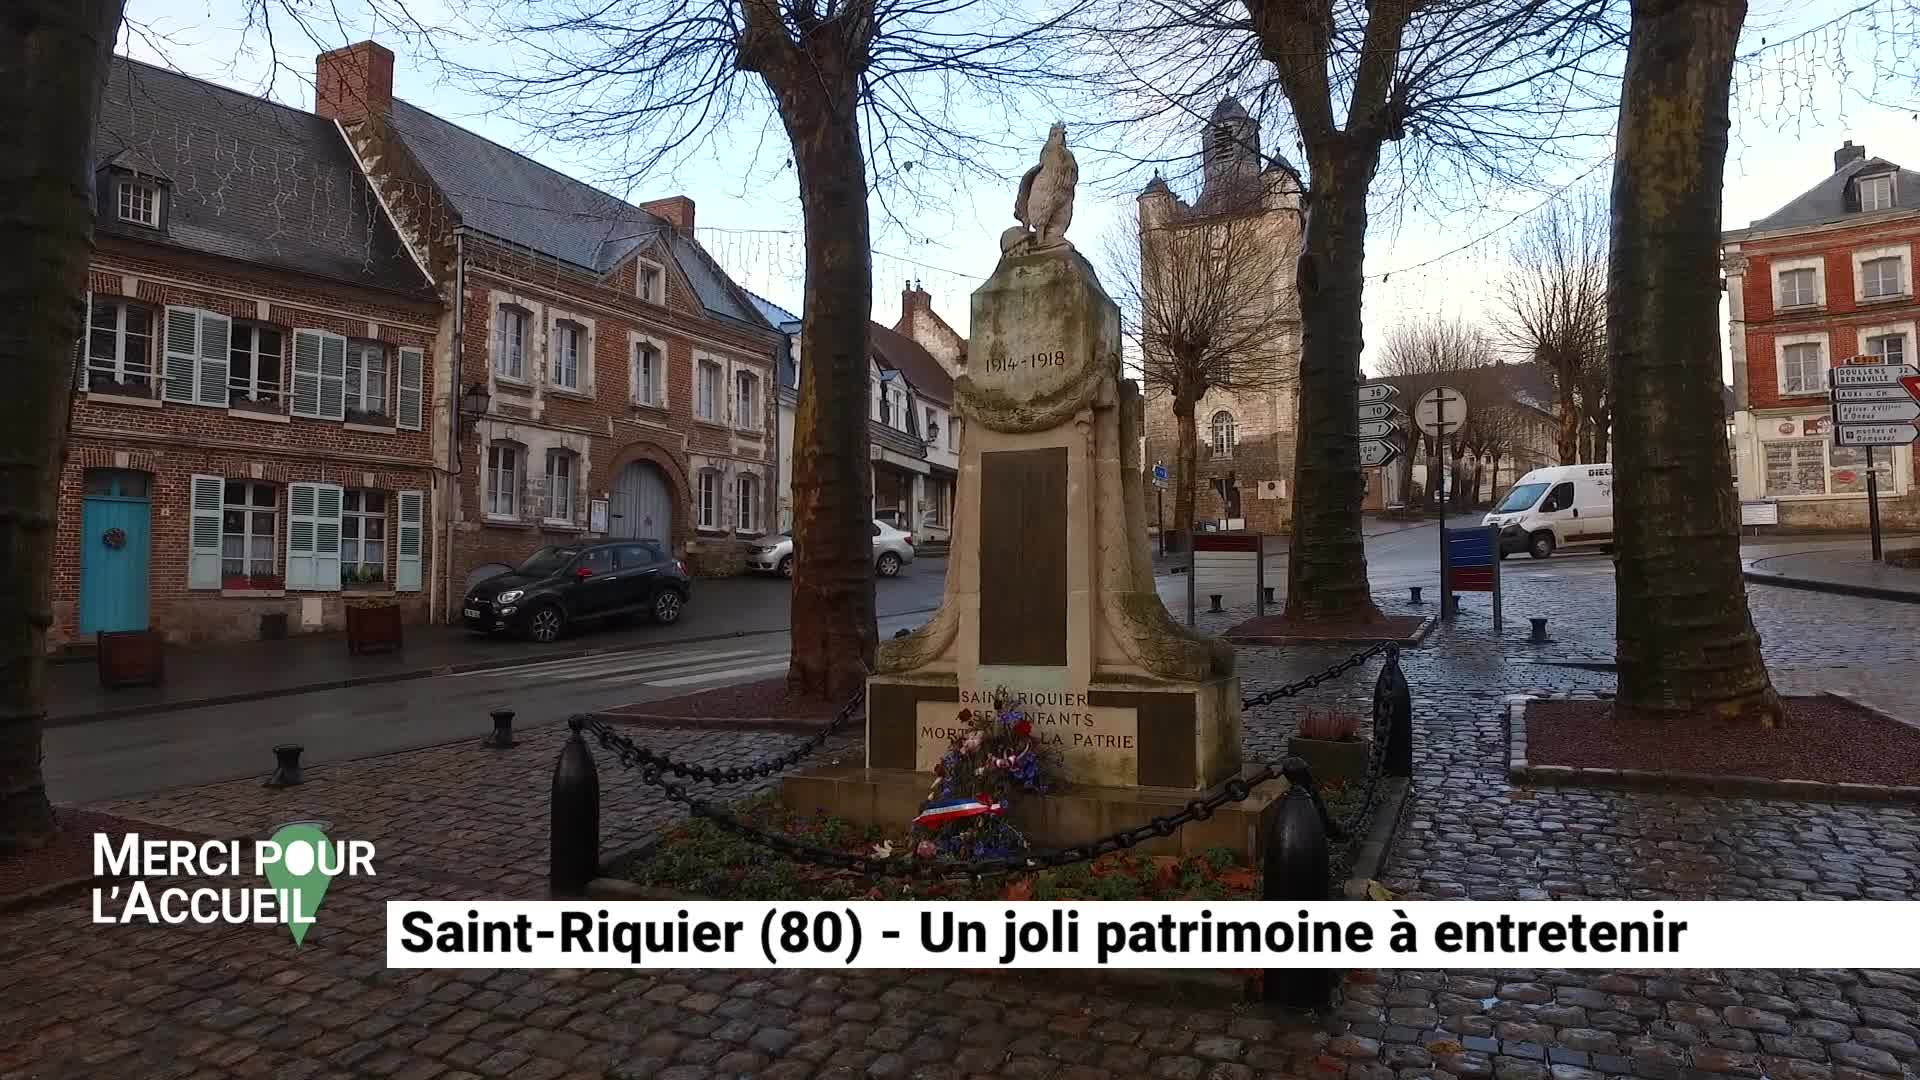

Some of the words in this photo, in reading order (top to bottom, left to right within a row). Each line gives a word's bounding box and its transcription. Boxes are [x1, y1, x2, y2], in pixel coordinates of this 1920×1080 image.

[1839, 367, 1887, 376] DOULLENS
[1840, 375, 1889, 383] BERNAVILLE
[1372, 407, 1382, 415] 10
[1588, 468, 1612, 477] DIEC
[961, 690, 1007, 704] SAIN
[1017, 692, 1089, 708] RIQUIER
[1014, 710, 1095, 728] NFANTS
[920, 725, 972, 743] MORT
[1041, 731, 1064, 746] LA
[1073, 733, 1135, 749] PATRIE
